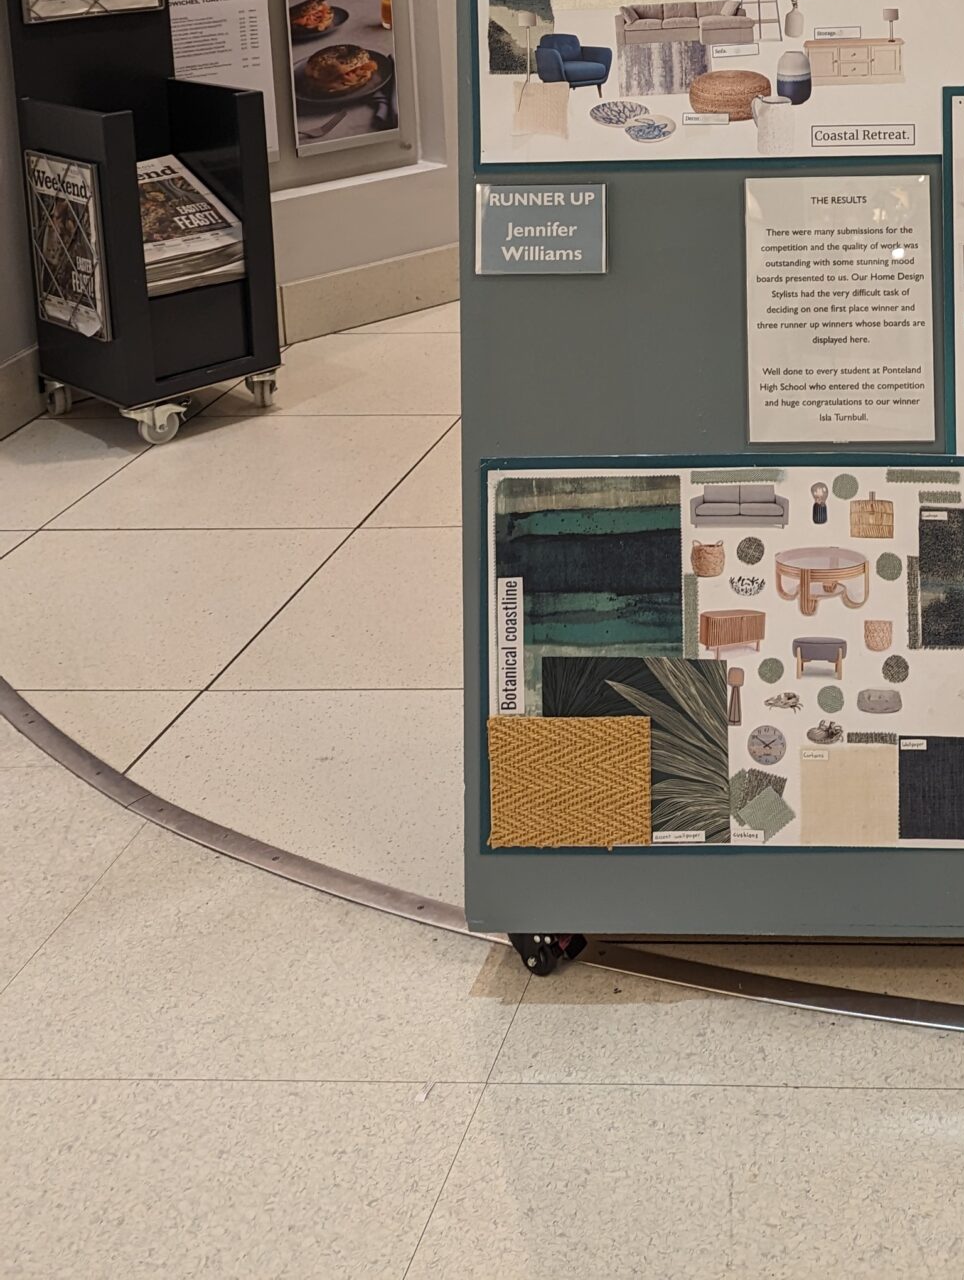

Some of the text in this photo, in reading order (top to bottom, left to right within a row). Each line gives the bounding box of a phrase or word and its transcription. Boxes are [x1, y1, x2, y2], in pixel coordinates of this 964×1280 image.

[168, 0, 200, 7] DWICHES,
[814, 129, 910, 141] Coastal Retreat.
[31, 170, 89, 199] Weekend
[489, 192, 595, 206] RUNNER UP
[810, 195, 867, 205] THE RESULTS
[175, 202, 212, 216] EASTER
[173, 212, 222, 231] FEAST!
[505, 222, 578, 241] Jennifer
[765, 227, 790, 236] There
[814, 229, 835, 237] many
[836, 226, 884, 235] submissions
[885, 225, 898, 234] for
[899, 225, 913, 234] the
[501, 245, 582, 262] Williams
[76, 255, 93, 273] EASTER
[72, 271, 95, 298] FEAST!
[819, 412, 868, 421] Isla Turnbull.
[501, 580, 518, 711] Botanical coastline
